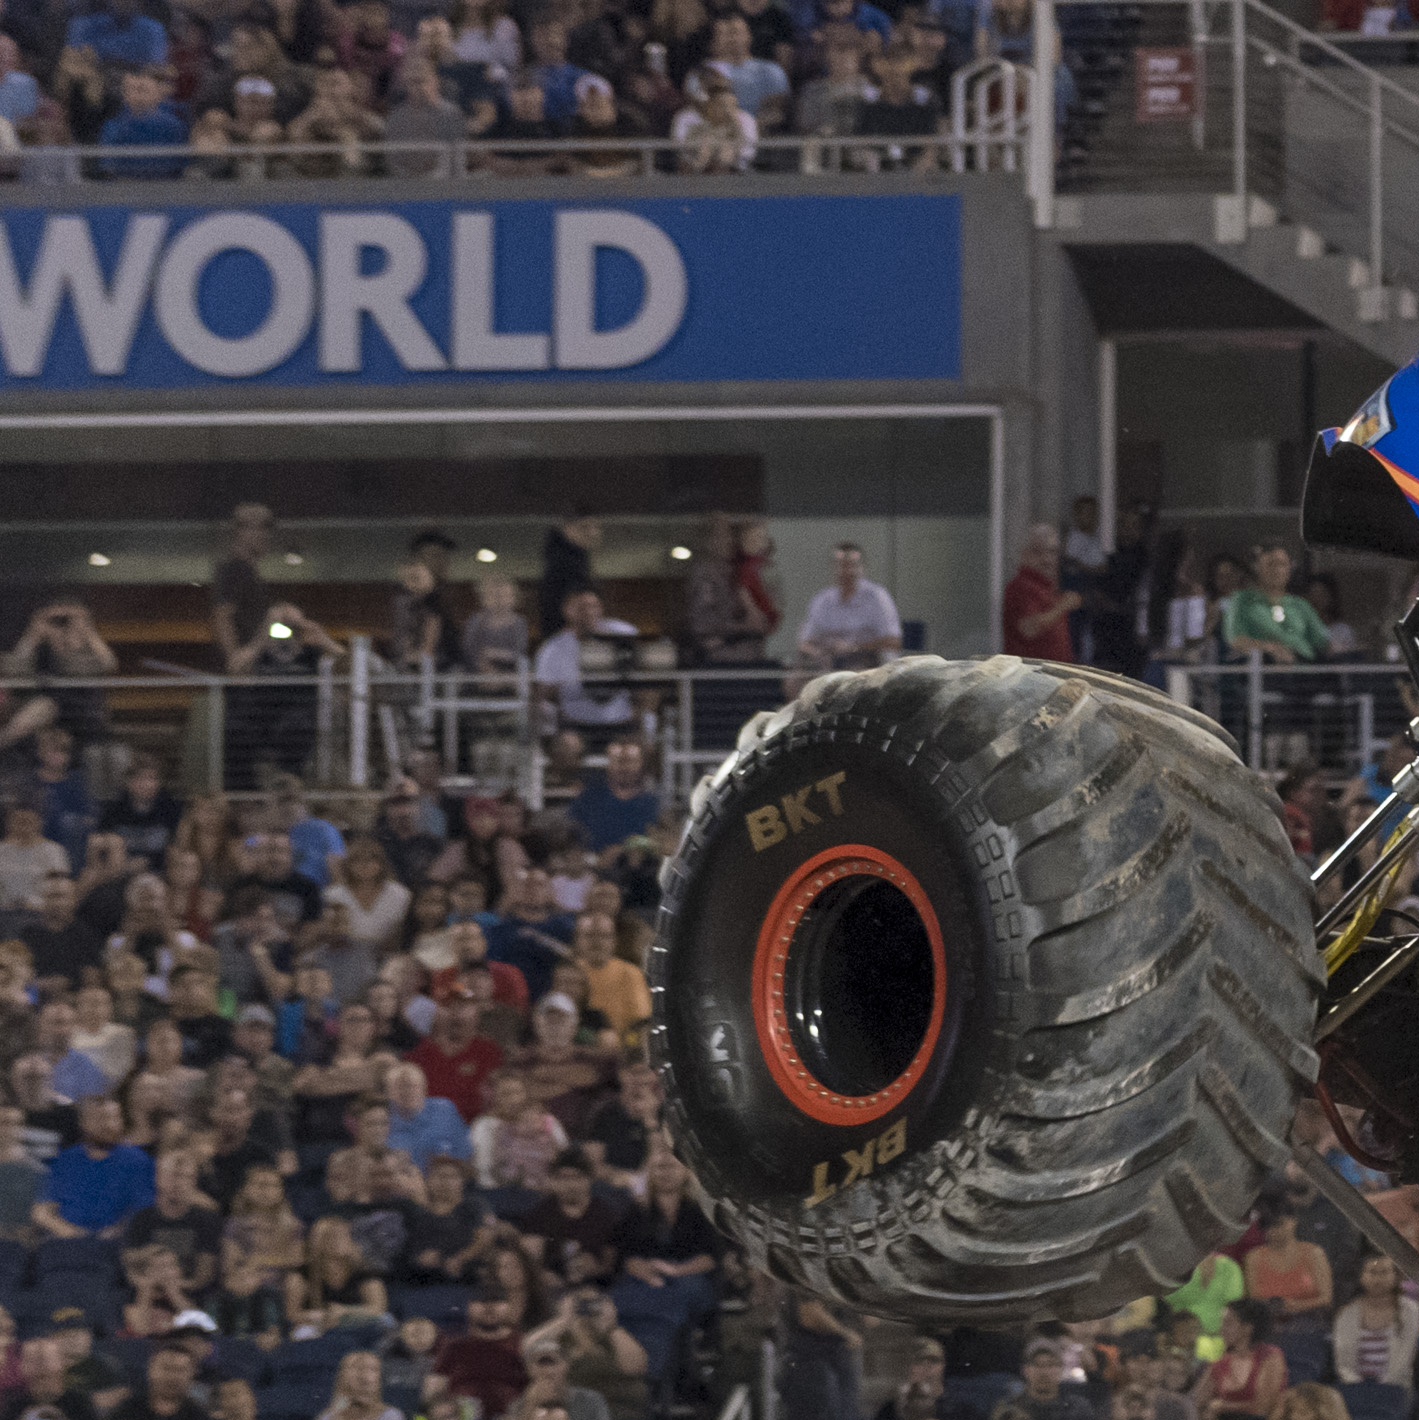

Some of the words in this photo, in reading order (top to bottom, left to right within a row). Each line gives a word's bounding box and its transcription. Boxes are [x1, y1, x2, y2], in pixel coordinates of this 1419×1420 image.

[0, 209, 688, 378] WORLD
[745, 771, 846, 853] BKT
[804, 1116, 907, 1209] BKT
